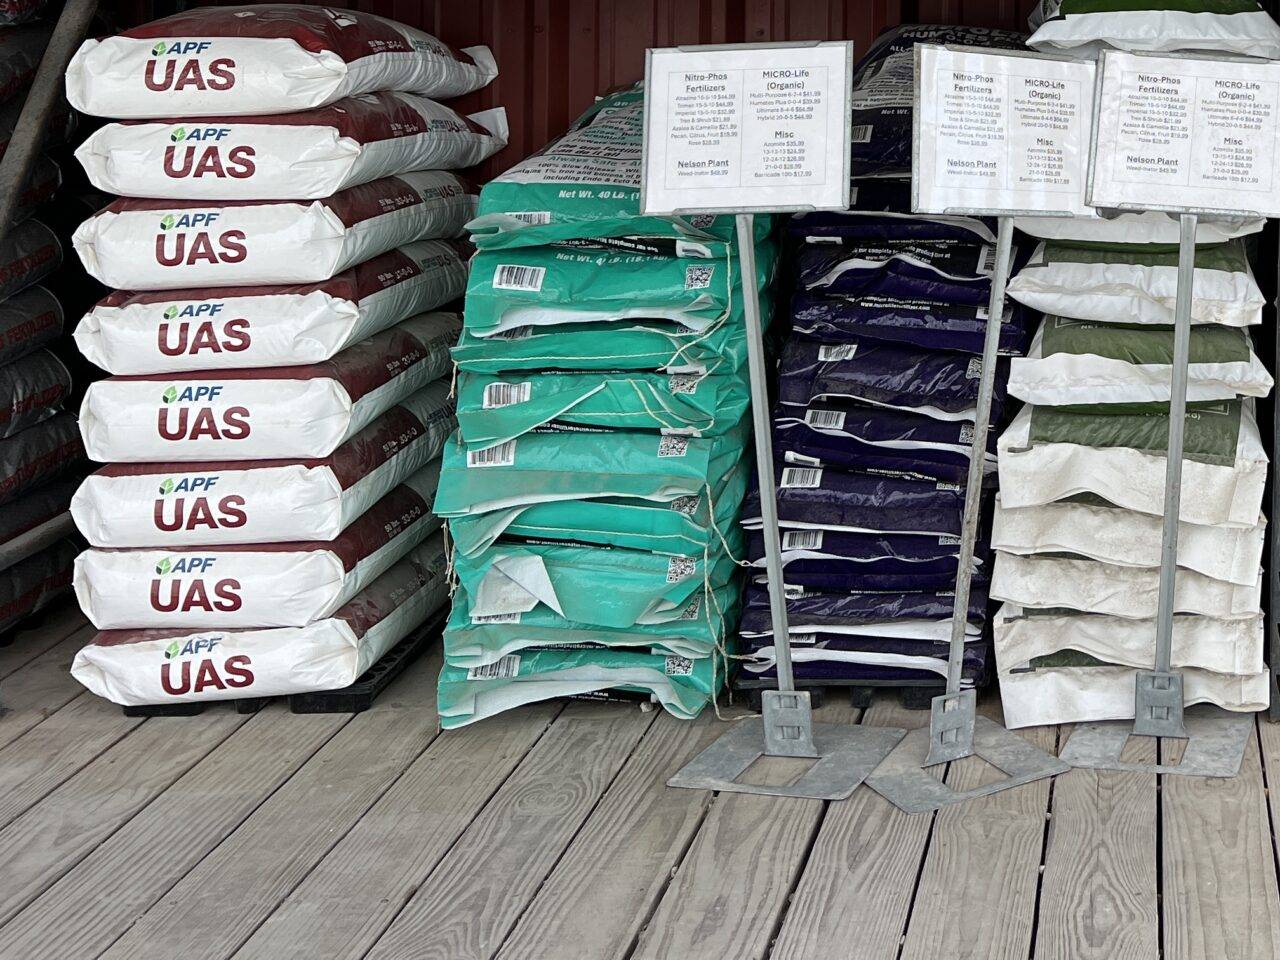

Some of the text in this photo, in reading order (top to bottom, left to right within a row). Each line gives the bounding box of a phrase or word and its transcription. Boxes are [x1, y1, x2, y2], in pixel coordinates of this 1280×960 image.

[166, 41, 211, 55] APF
[144, 58, 236, 92] UAS
[684, 73, 728, 81] Nitro-Phos
[763, 70, 809, 78] MICRO-Life
[952, 73, 994, 84] Nitro-Phos
[767, 81, 805, 90] (Organic)
[1024, 79, 1065, 90] MICRO-Life
[1138, 75, 1181, 85] Nitro-Phos
[1215, 80, 1260, 90] MICRO-Life
[686, 84, 726, 93] Fertilizers
[954, 84, 992, 94] Fertilizers
[1138, 85, 1179, 95] Fertilizers
[1028, 90, 1061, 101] (Organic)
[1219, 91, 1255, 102] (Organic)
[185, 128, 231, 141] APF
[775, 131, 794, 139] Misc
[1036, 138, 1054, 146] Misc
[1224, 137, 1243, 145] Misc
[163, 145, 256, 179] UAS
[677, 159, 729, 169] Nelson Plant
[947, 159, 997, 168] Nelson Plant
[1126, 155, 1179, 166] Nelson Plant
[559, 190, 576, 198] Net
[578, 190, 595, 198] Wt.
[598, 191, 611, 199] 40
[175, 213, 220, 228] APF
[155, 229, 248, 267] UAS
[556, 253, 575, 261] Net
[179, 303, 224, 318] APF
[158, 318, 251, 356] UAS
[178, 386, 223, 402] APF
[158, 406, 251, 441] UAS
[174, 477, 219, 492] APF
[153, 494, 248, 532] UAS
[171, 557, 216, 573] APF
[150, 578, 243, 612] UAS
[180, 637, 222, 656] APF
[161, 655, 254, 696] UAS
